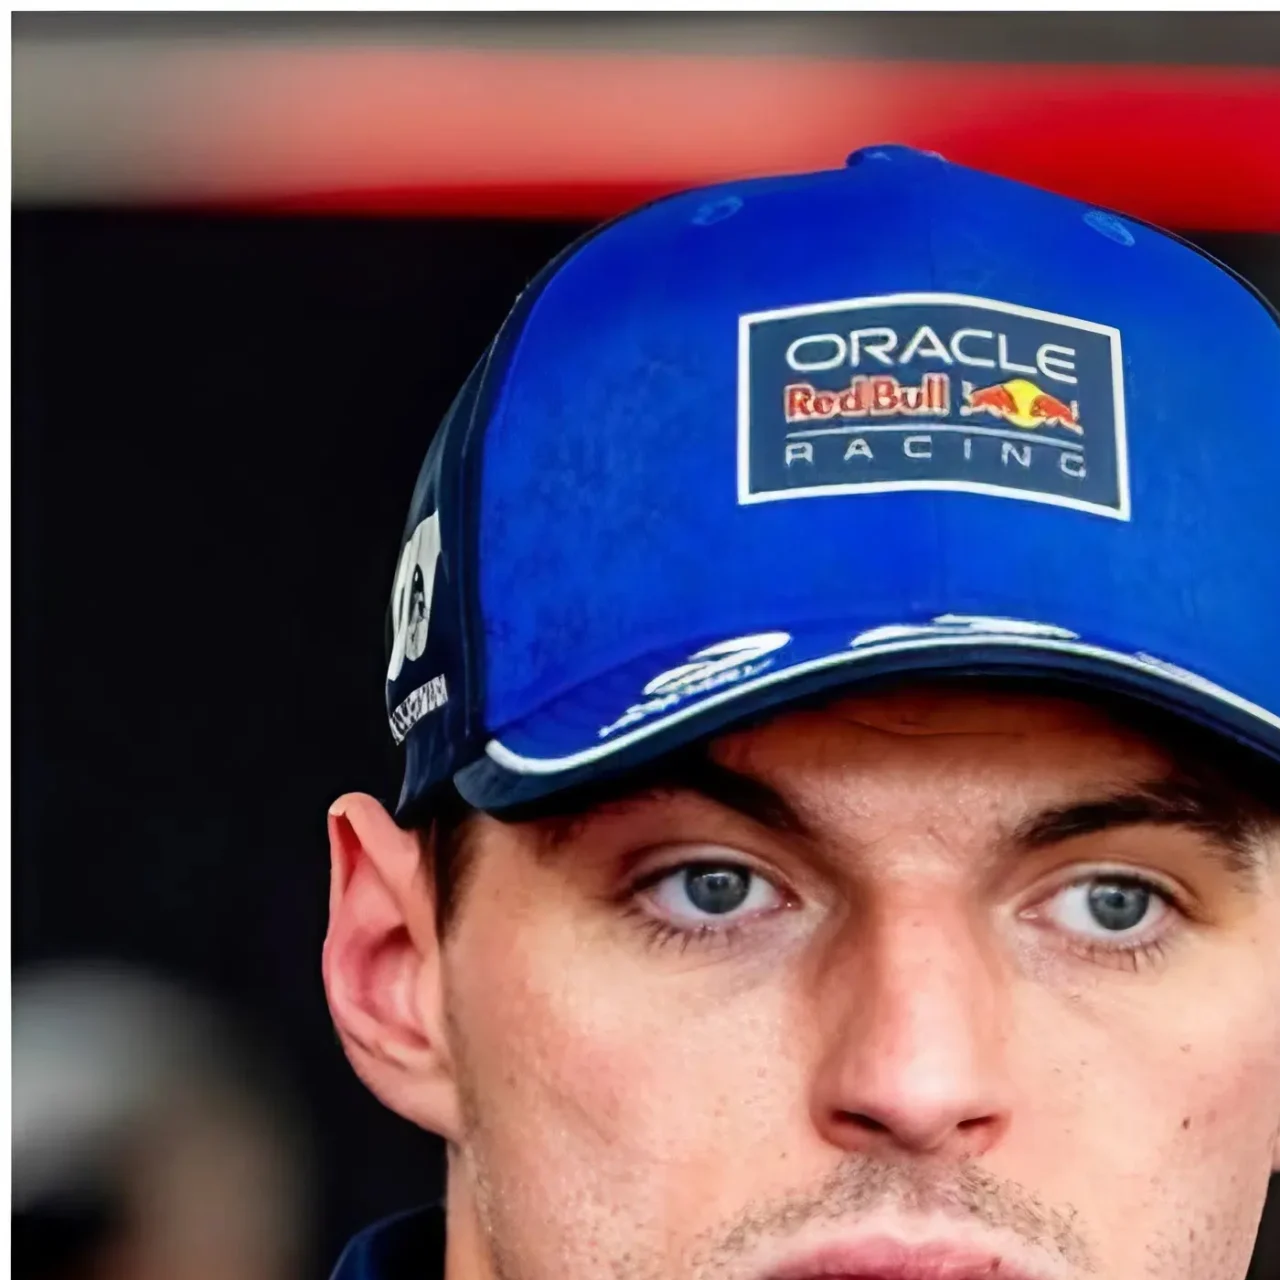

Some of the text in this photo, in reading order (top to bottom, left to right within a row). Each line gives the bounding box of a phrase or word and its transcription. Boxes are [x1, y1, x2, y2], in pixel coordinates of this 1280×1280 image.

[786, 325, 1078, 384] ORACLE
[784, 372, 950, 423] Red Bull
[785, 435, 1087, 478] RACING
